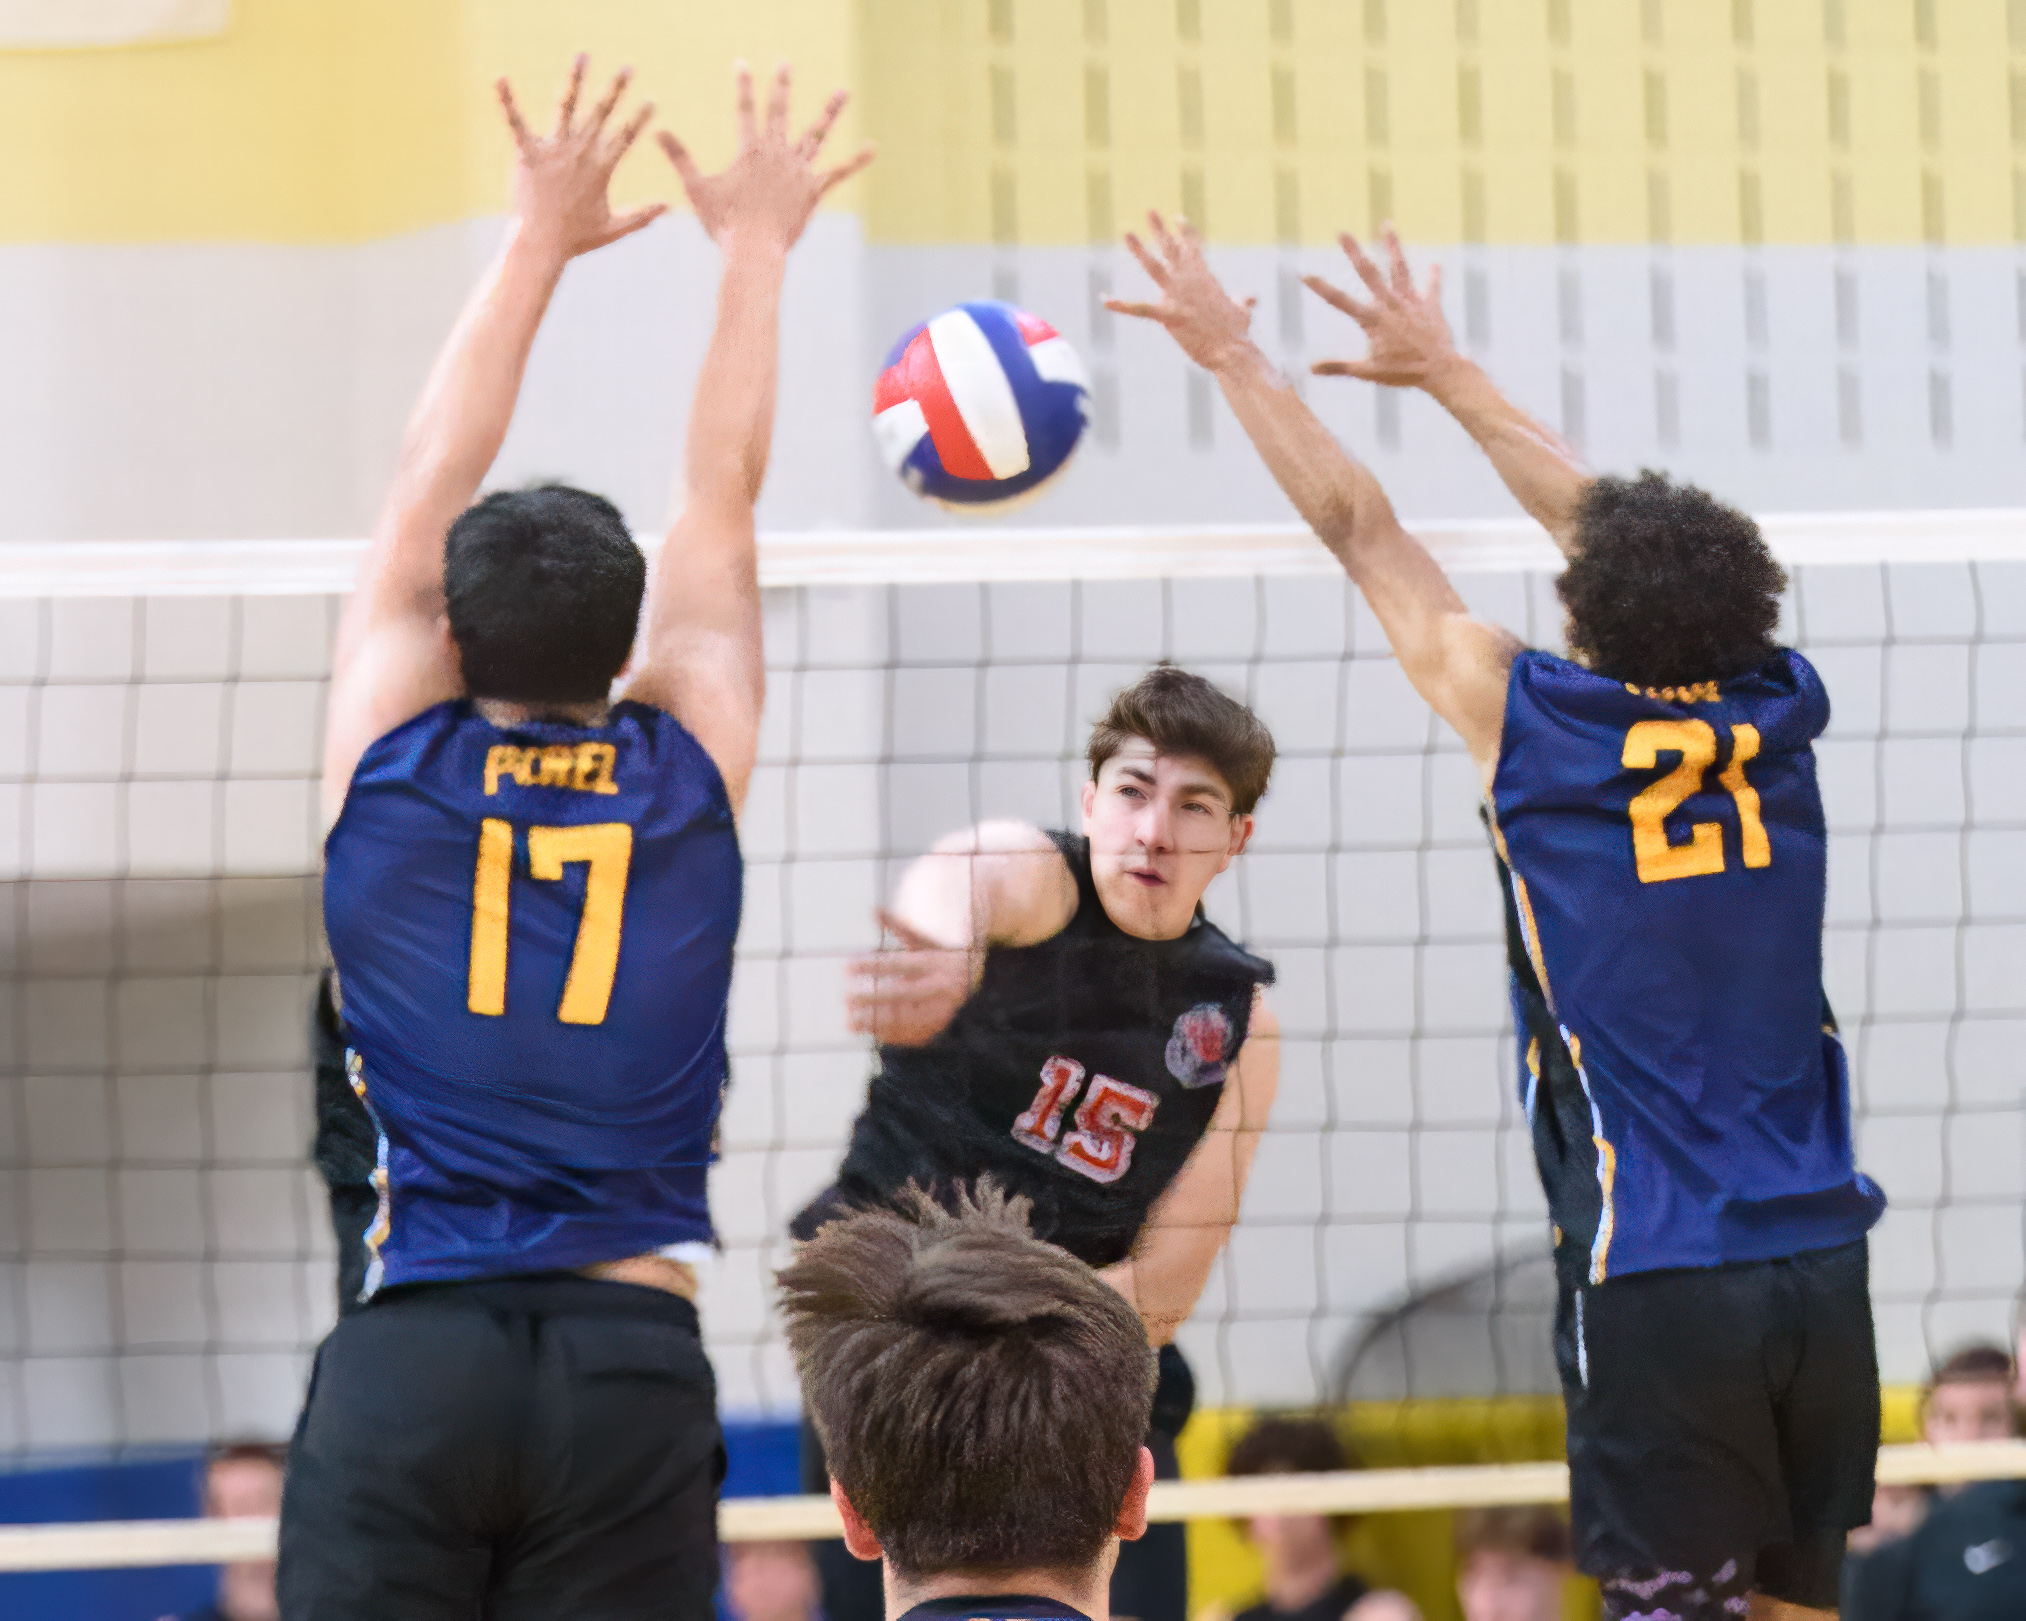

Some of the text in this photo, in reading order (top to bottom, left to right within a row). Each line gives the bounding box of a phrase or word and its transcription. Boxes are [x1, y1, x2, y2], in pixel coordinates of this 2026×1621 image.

[1621, 718, 1771, 884] 21
[468, 817, 632, 1025] 17
[1010, 1054, 1161, 1184] 15
